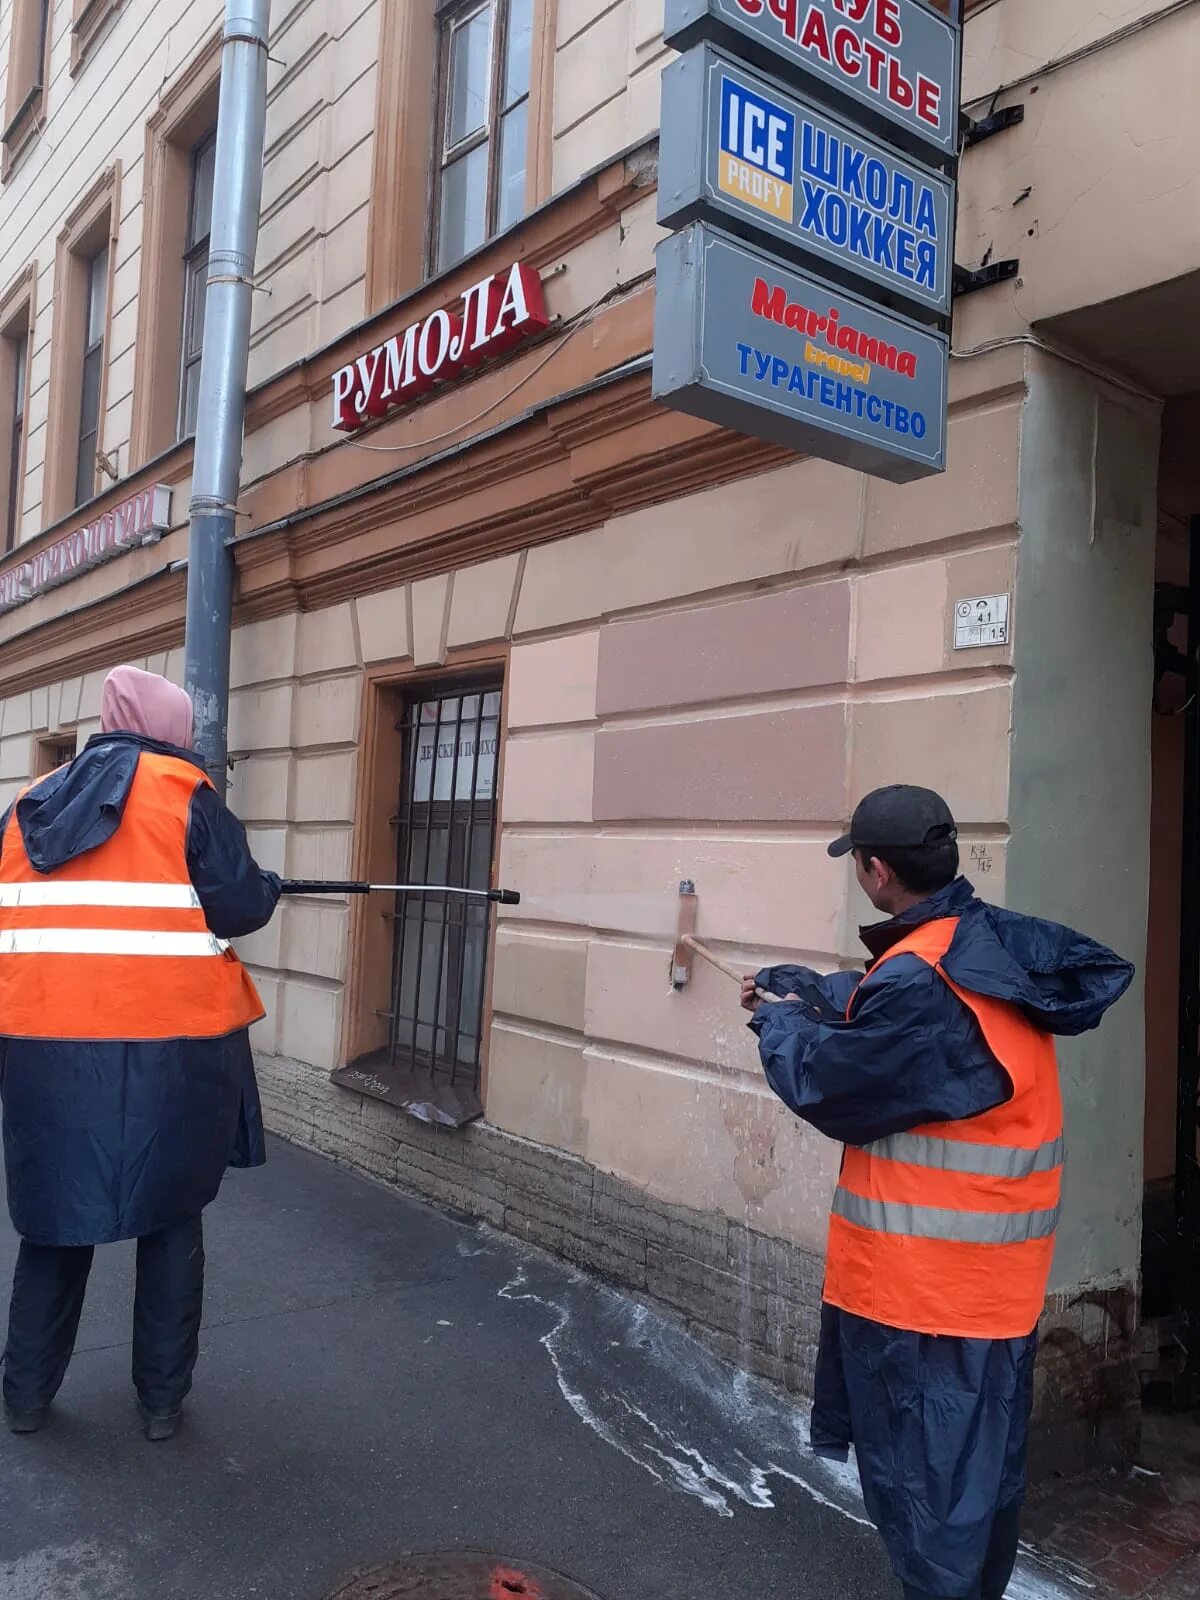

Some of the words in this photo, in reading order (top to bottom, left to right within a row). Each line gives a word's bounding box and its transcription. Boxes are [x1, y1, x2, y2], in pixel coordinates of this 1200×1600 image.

[727, 159, 785, 209] PROFY
[729, 94, 788, 178] ICE
[801, 121, 938, 240] ШКОЛА
[799, 176, 937, 292] ХОККЕЯ
[331, 262, 532, 429] РУМОЛА
[751, 277, 917, 380] Marianna
[804, 341, 871, 386] travel
[736, 344, 927, 440] ТУРАГЕНТСТВО
